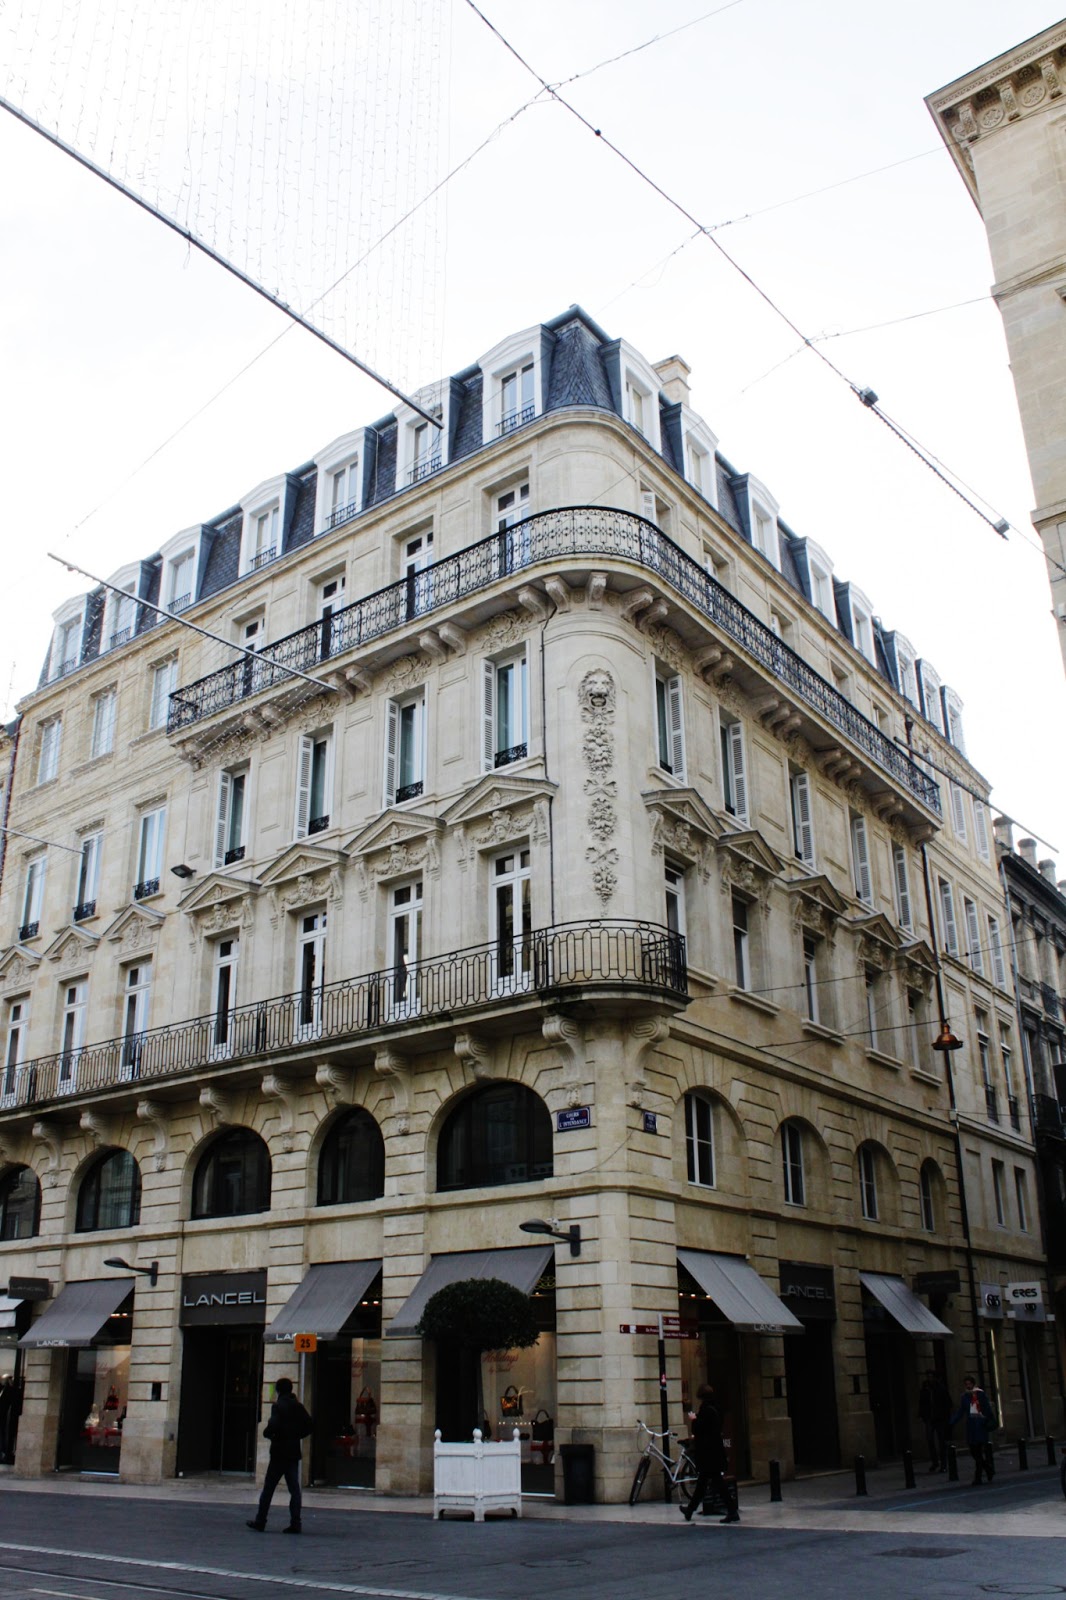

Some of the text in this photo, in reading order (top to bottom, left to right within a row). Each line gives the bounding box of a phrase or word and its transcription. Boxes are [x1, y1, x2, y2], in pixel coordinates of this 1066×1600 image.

[1012, 1288, 1038, 1298] ERES
[184, 1291, 266, 1307] LANCEL
[753, 1323, 786, 1333] LANCEL
[36, 1339, 69, 1347] LANCEL
[300, 1338, 311, 1348] 25
